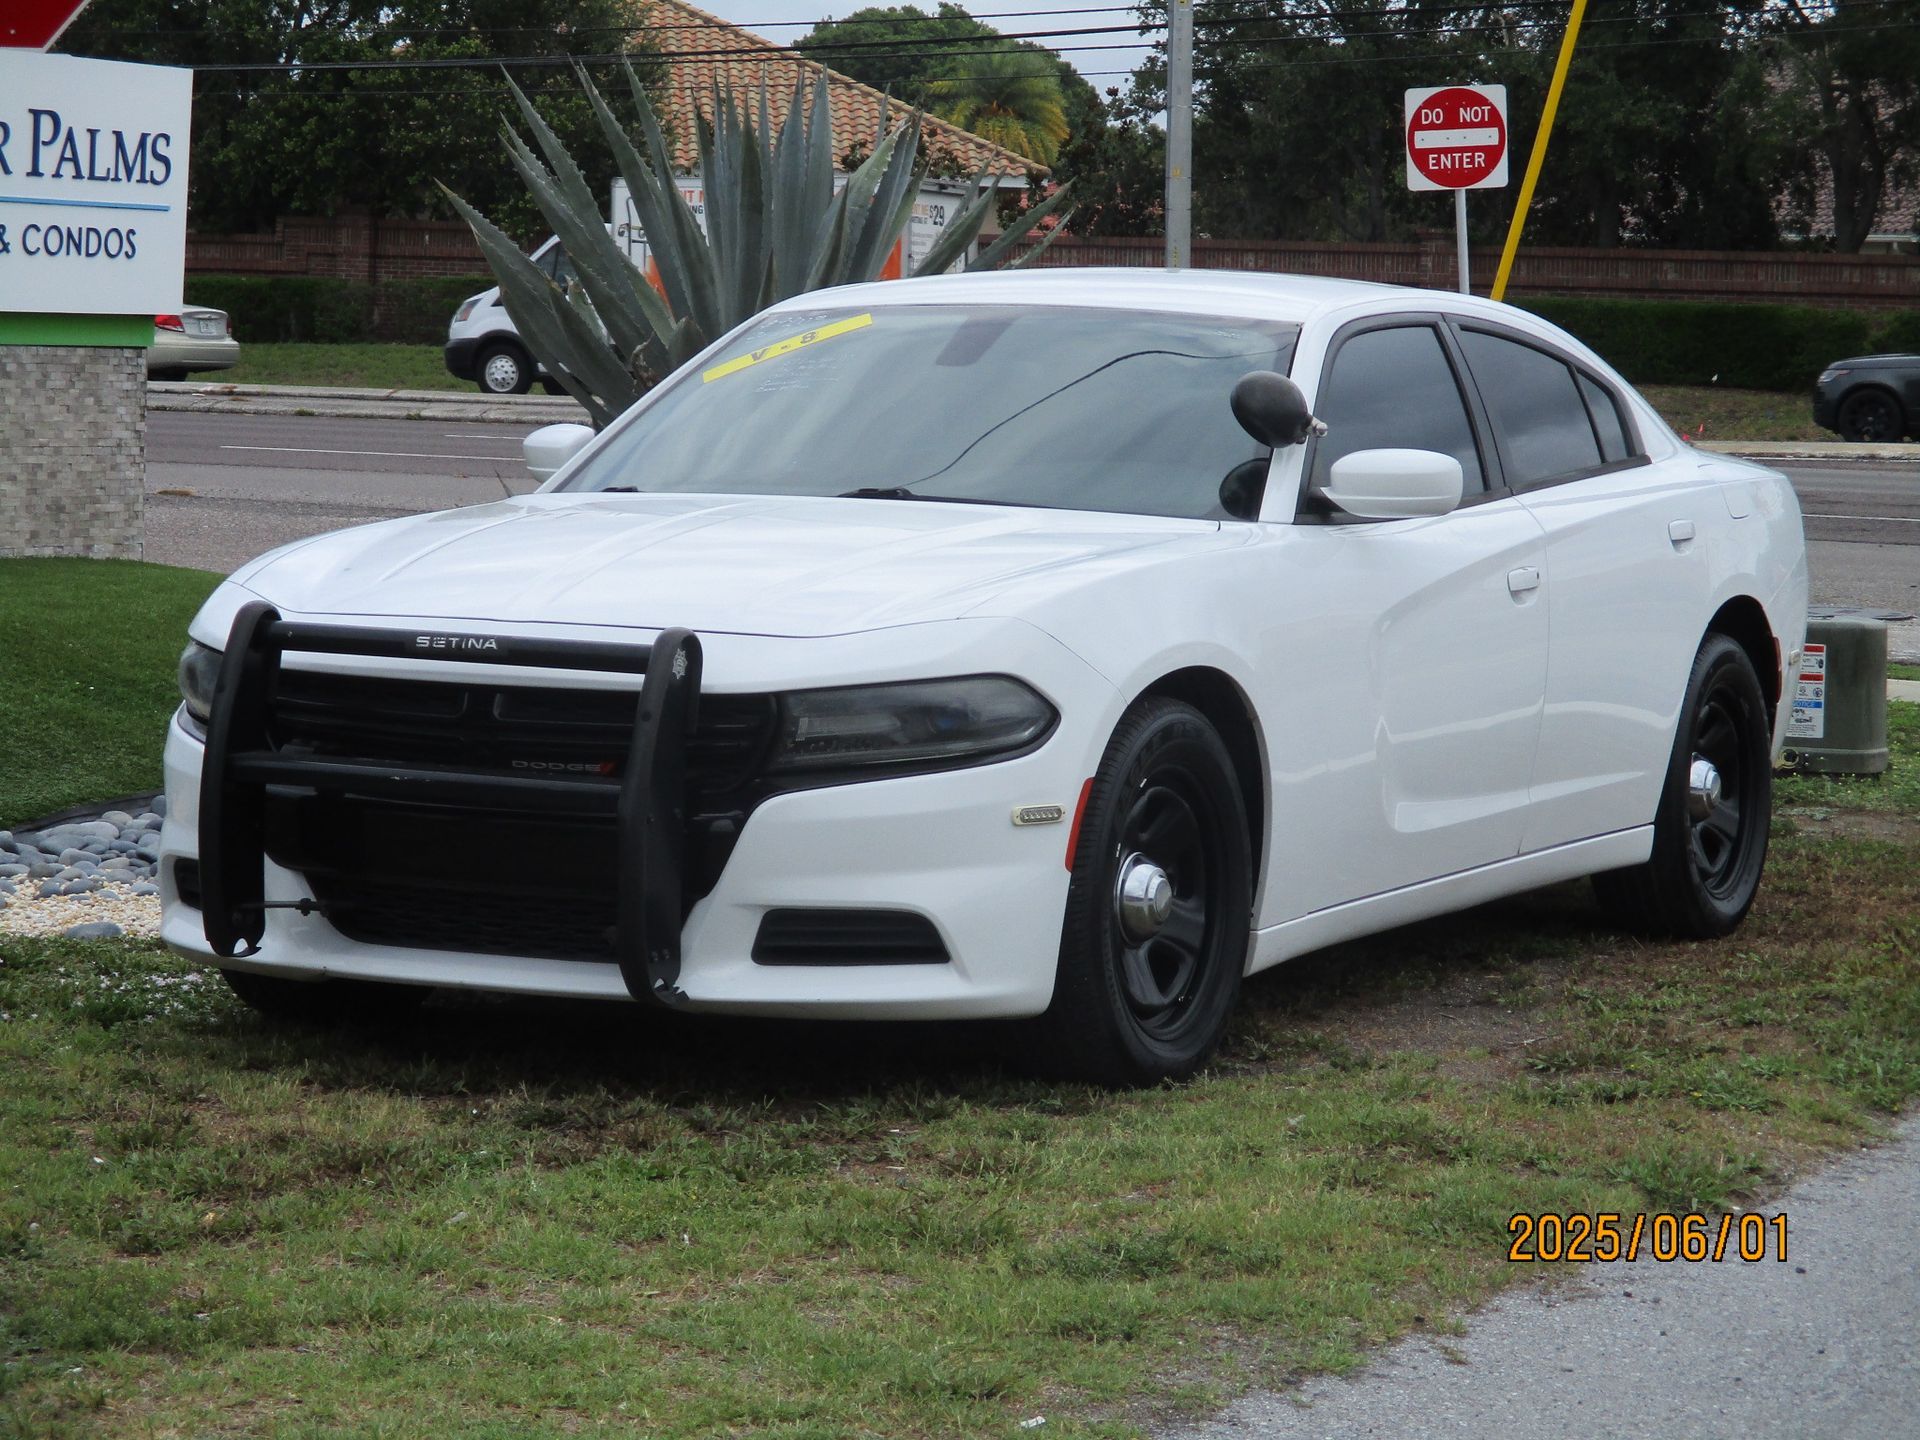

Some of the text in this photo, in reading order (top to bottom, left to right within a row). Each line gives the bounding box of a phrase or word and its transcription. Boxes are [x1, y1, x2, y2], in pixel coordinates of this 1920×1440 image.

[1421, 106, 1491, 124] DO NOT
[26, 108, 172, 185] PALMS
[1428, 152, 1485, 170] ENTER
[22, 223, 137, 259] CONDOS
[415, 636, 498, 650] SETINA
[511, 760, 601, 772] DODGE
